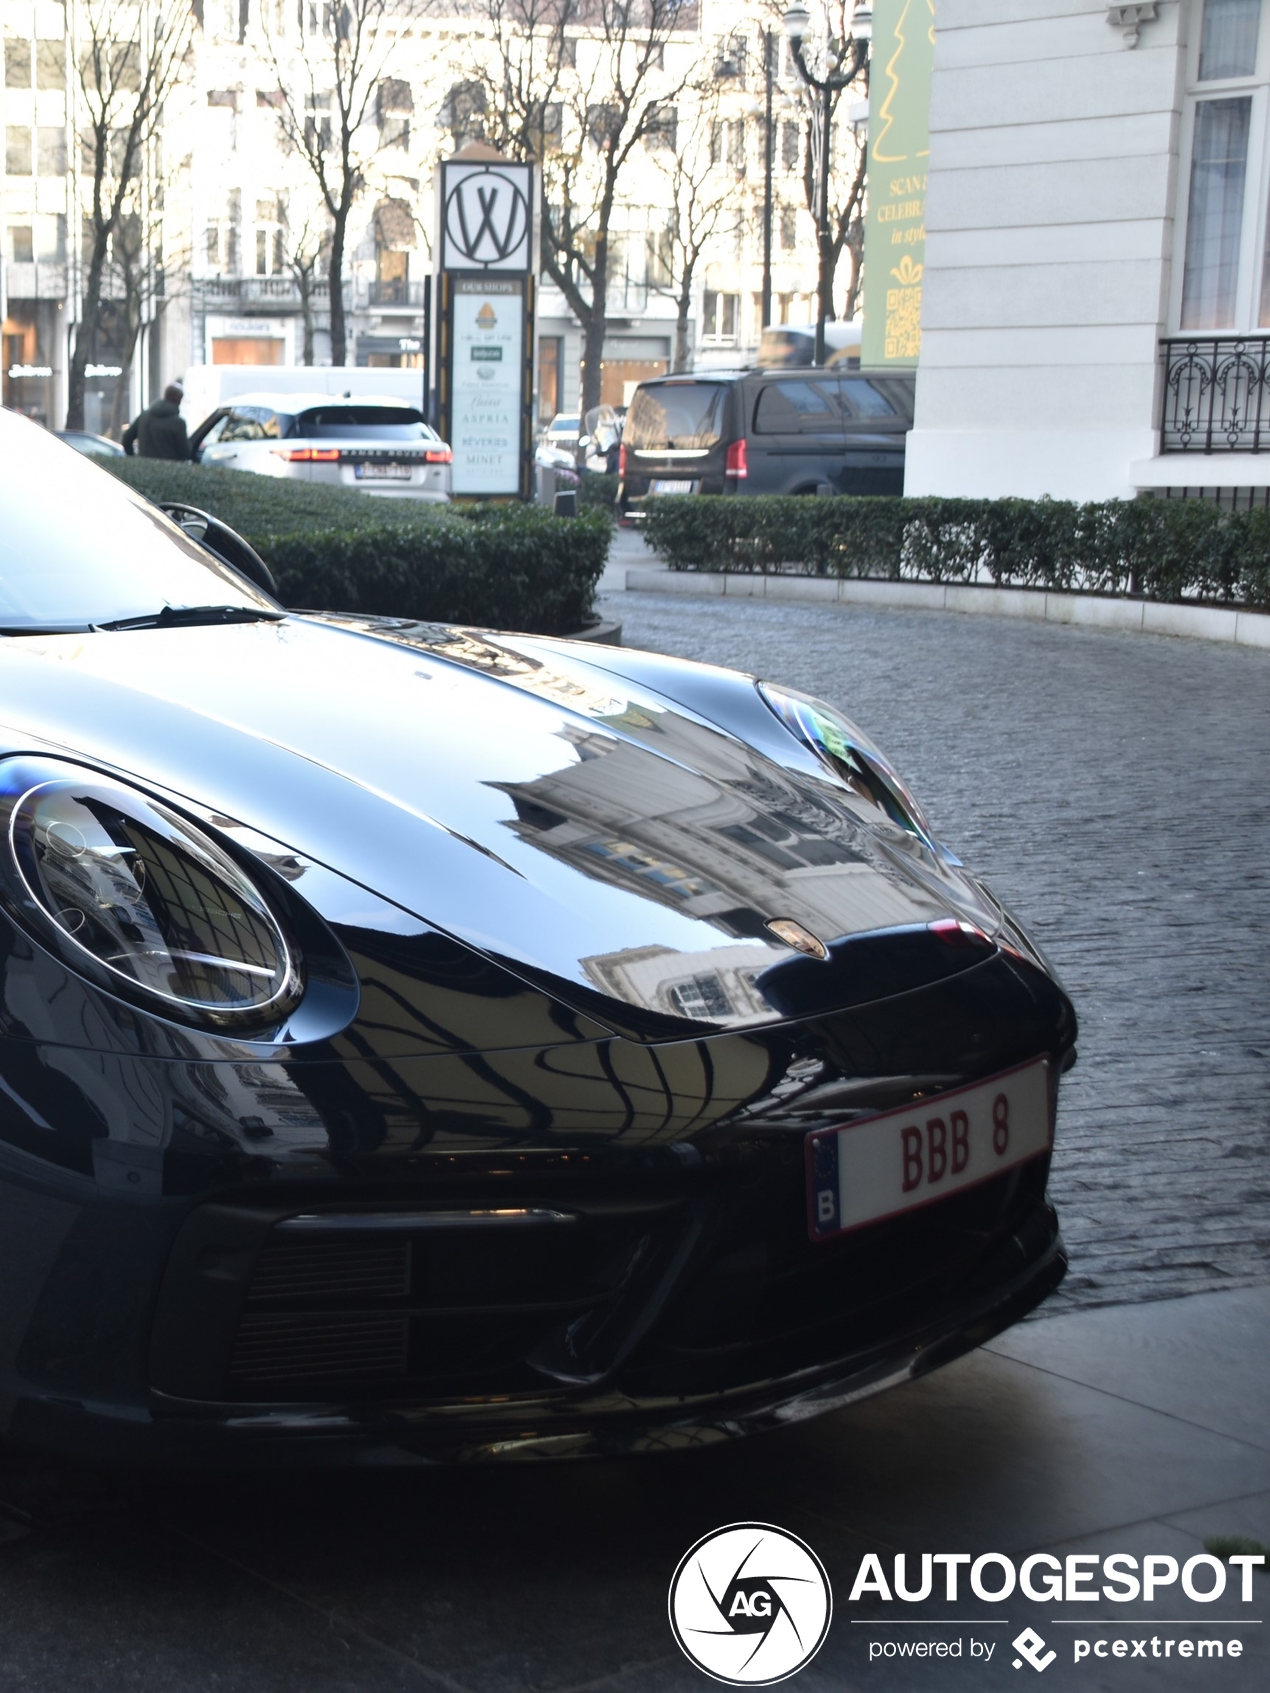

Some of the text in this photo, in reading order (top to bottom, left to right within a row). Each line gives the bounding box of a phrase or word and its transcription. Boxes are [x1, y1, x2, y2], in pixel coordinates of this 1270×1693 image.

[890, 174, 921, 197] SCAN
[891, 227, 902, 245] in
[462, 282, 513, 292] OUR SHOPS
[399, 338, 421, 351] The
[462, 414, 509, 424] ASPRIA
[466, 454, 503, 464] MINET
[901, 1092, 1009, 1193] BBB 8
[817, 1189, 835, 1222] B
